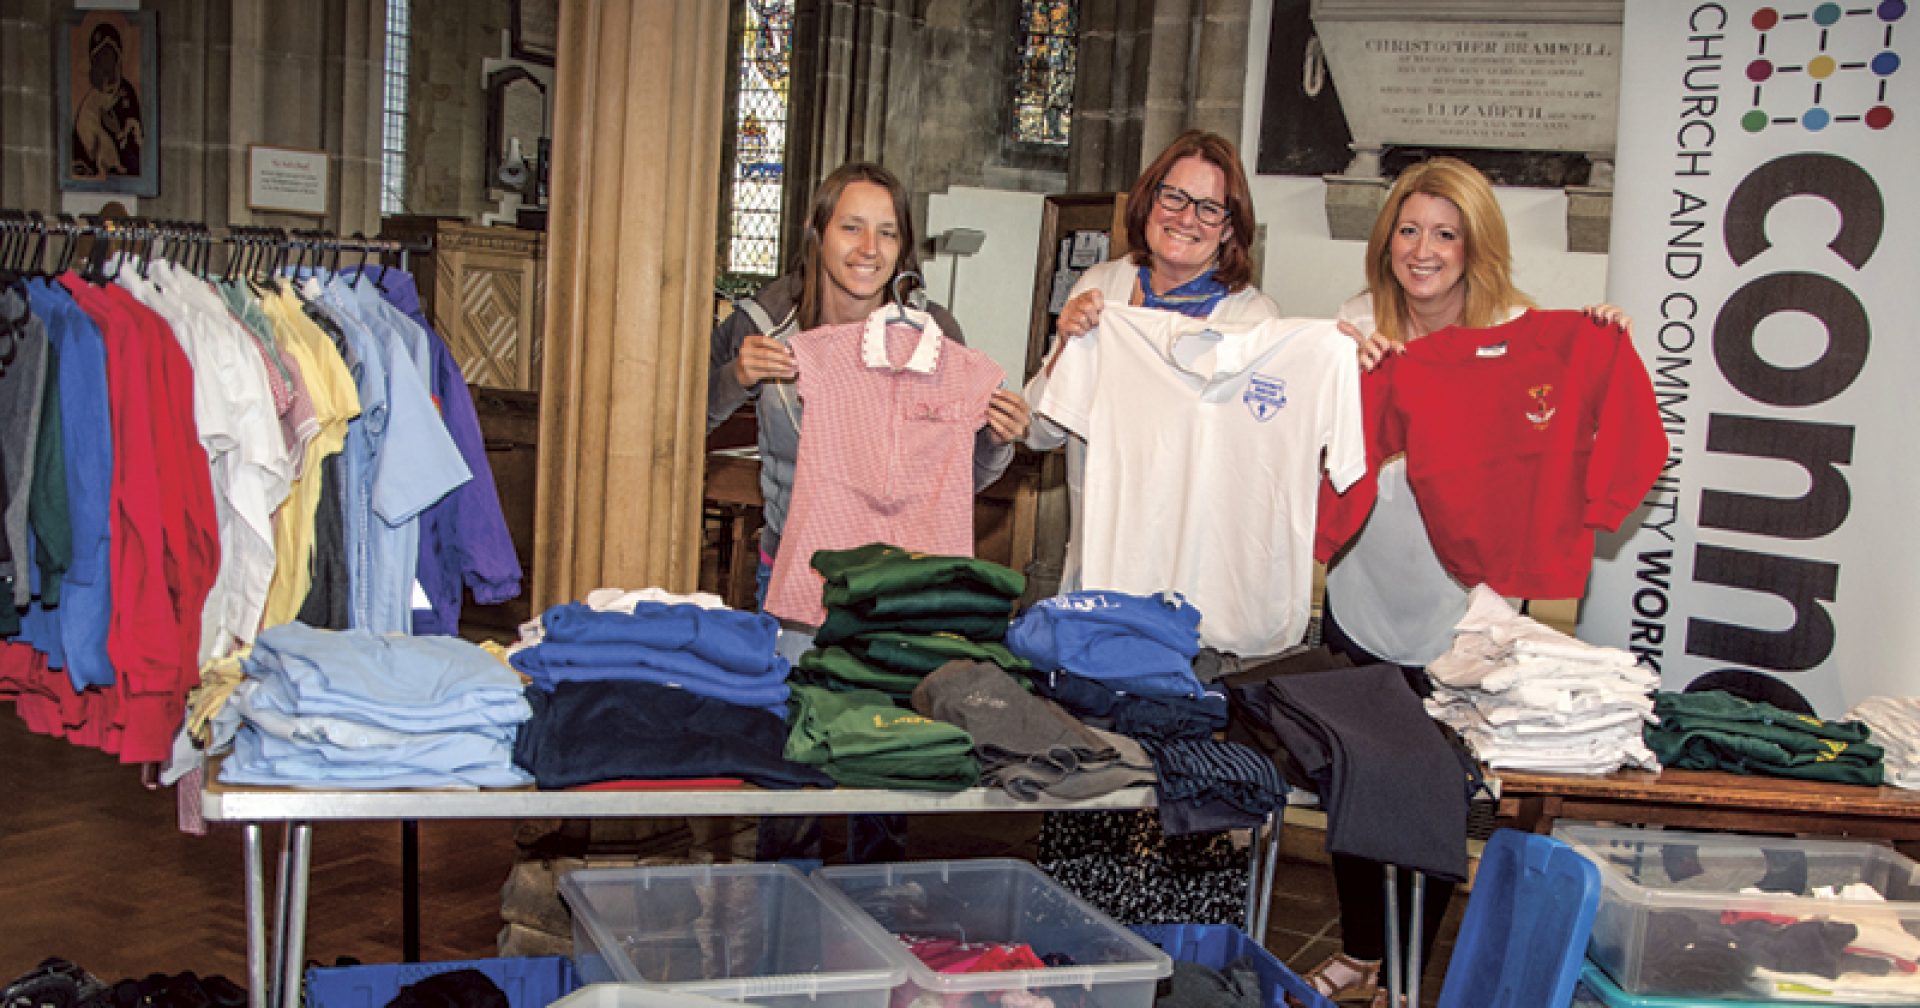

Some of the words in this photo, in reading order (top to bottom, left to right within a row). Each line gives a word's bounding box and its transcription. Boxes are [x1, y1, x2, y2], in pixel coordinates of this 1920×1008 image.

[1674, 2, 1728, 177] CHURCH
[1664, 188, 1707, 280] AND
[1629, 549, 1674, 675] WORK
